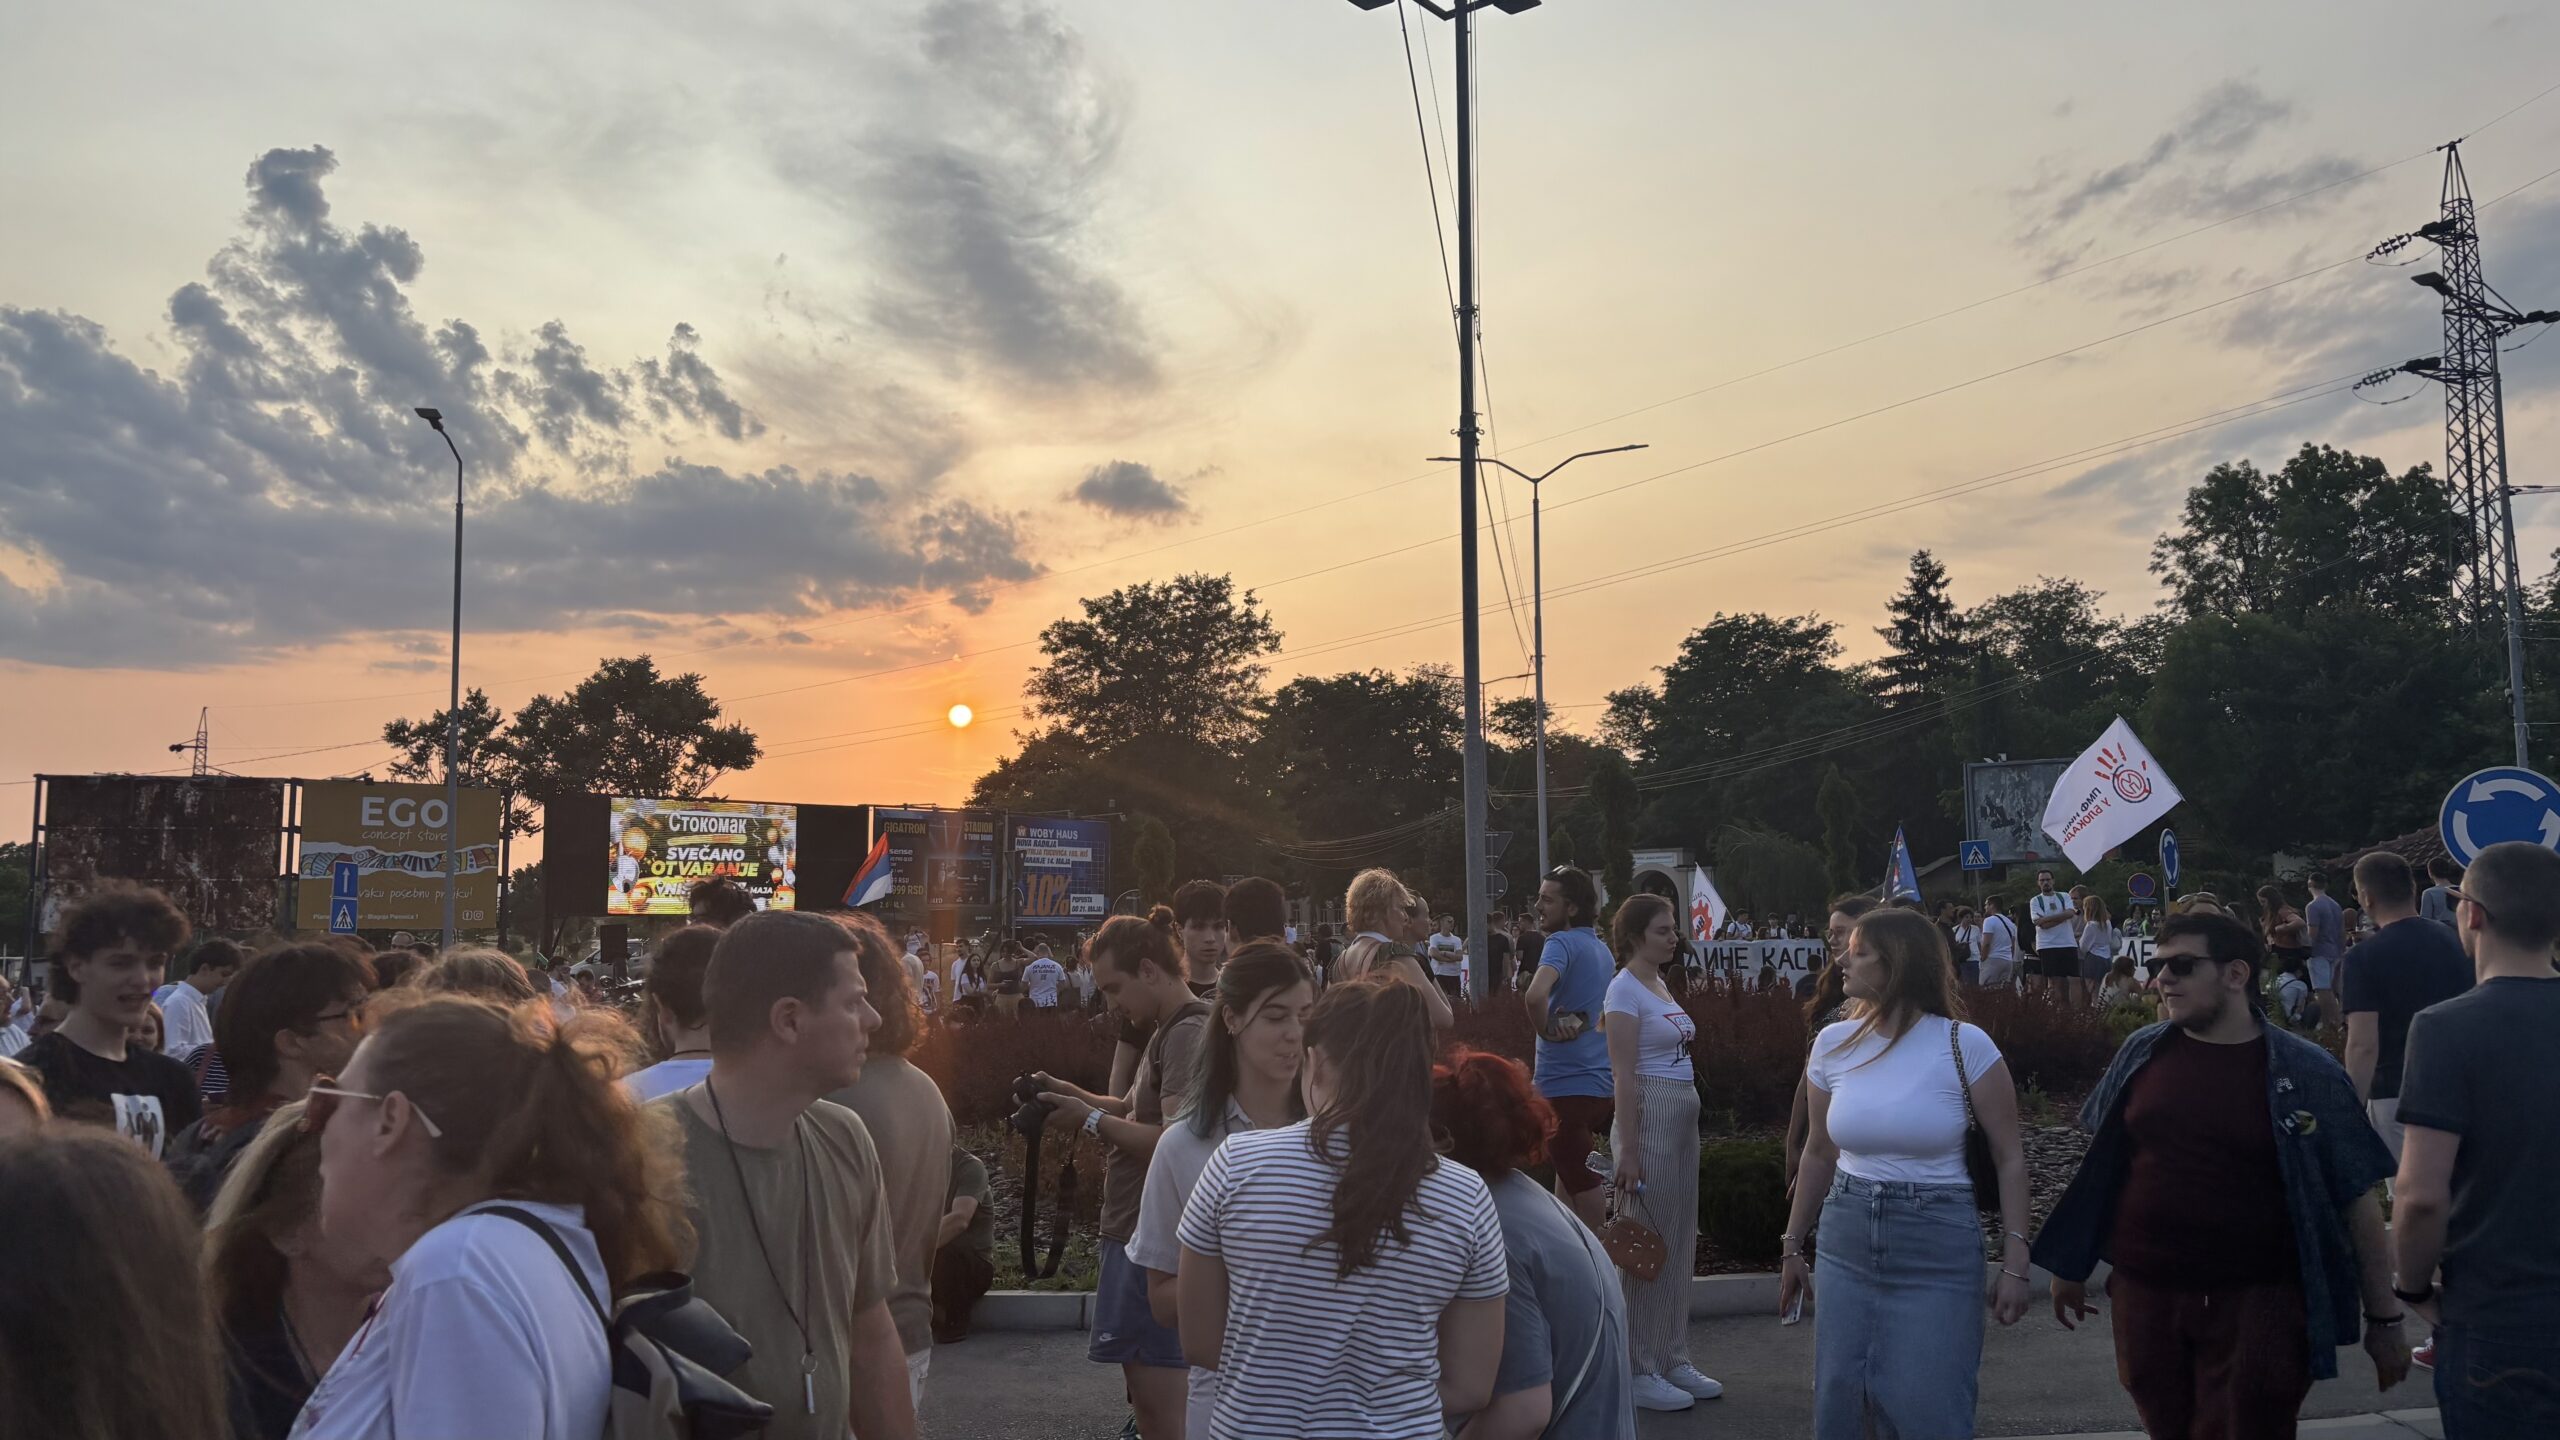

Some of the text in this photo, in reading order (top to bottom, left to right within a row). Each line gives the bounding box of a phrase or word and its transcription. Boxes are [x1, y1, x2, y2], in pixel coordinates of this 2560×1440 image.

[361, 796, 449, 829] EGO
[884, 822, 926, 834] GIGATRON
[964, 821, 993, 833] STADION
[1029, 828, 1055, 839] WOBY
[1056, 829, 1078, 840] HAUS
[362, 829, 448, 846] concept store
[666, 845, 745, 861] SVEČANO
[889, 848, 913, 856] sense
[651, 860, 760, 877] OTVARANJE
[358, 887, 472, 904] vaku posebnu priku!
[750, 886, 773, 894] MAJA
[907, 885, 924, 895] RSD
[1023, 873, 1072, 916] 10%
